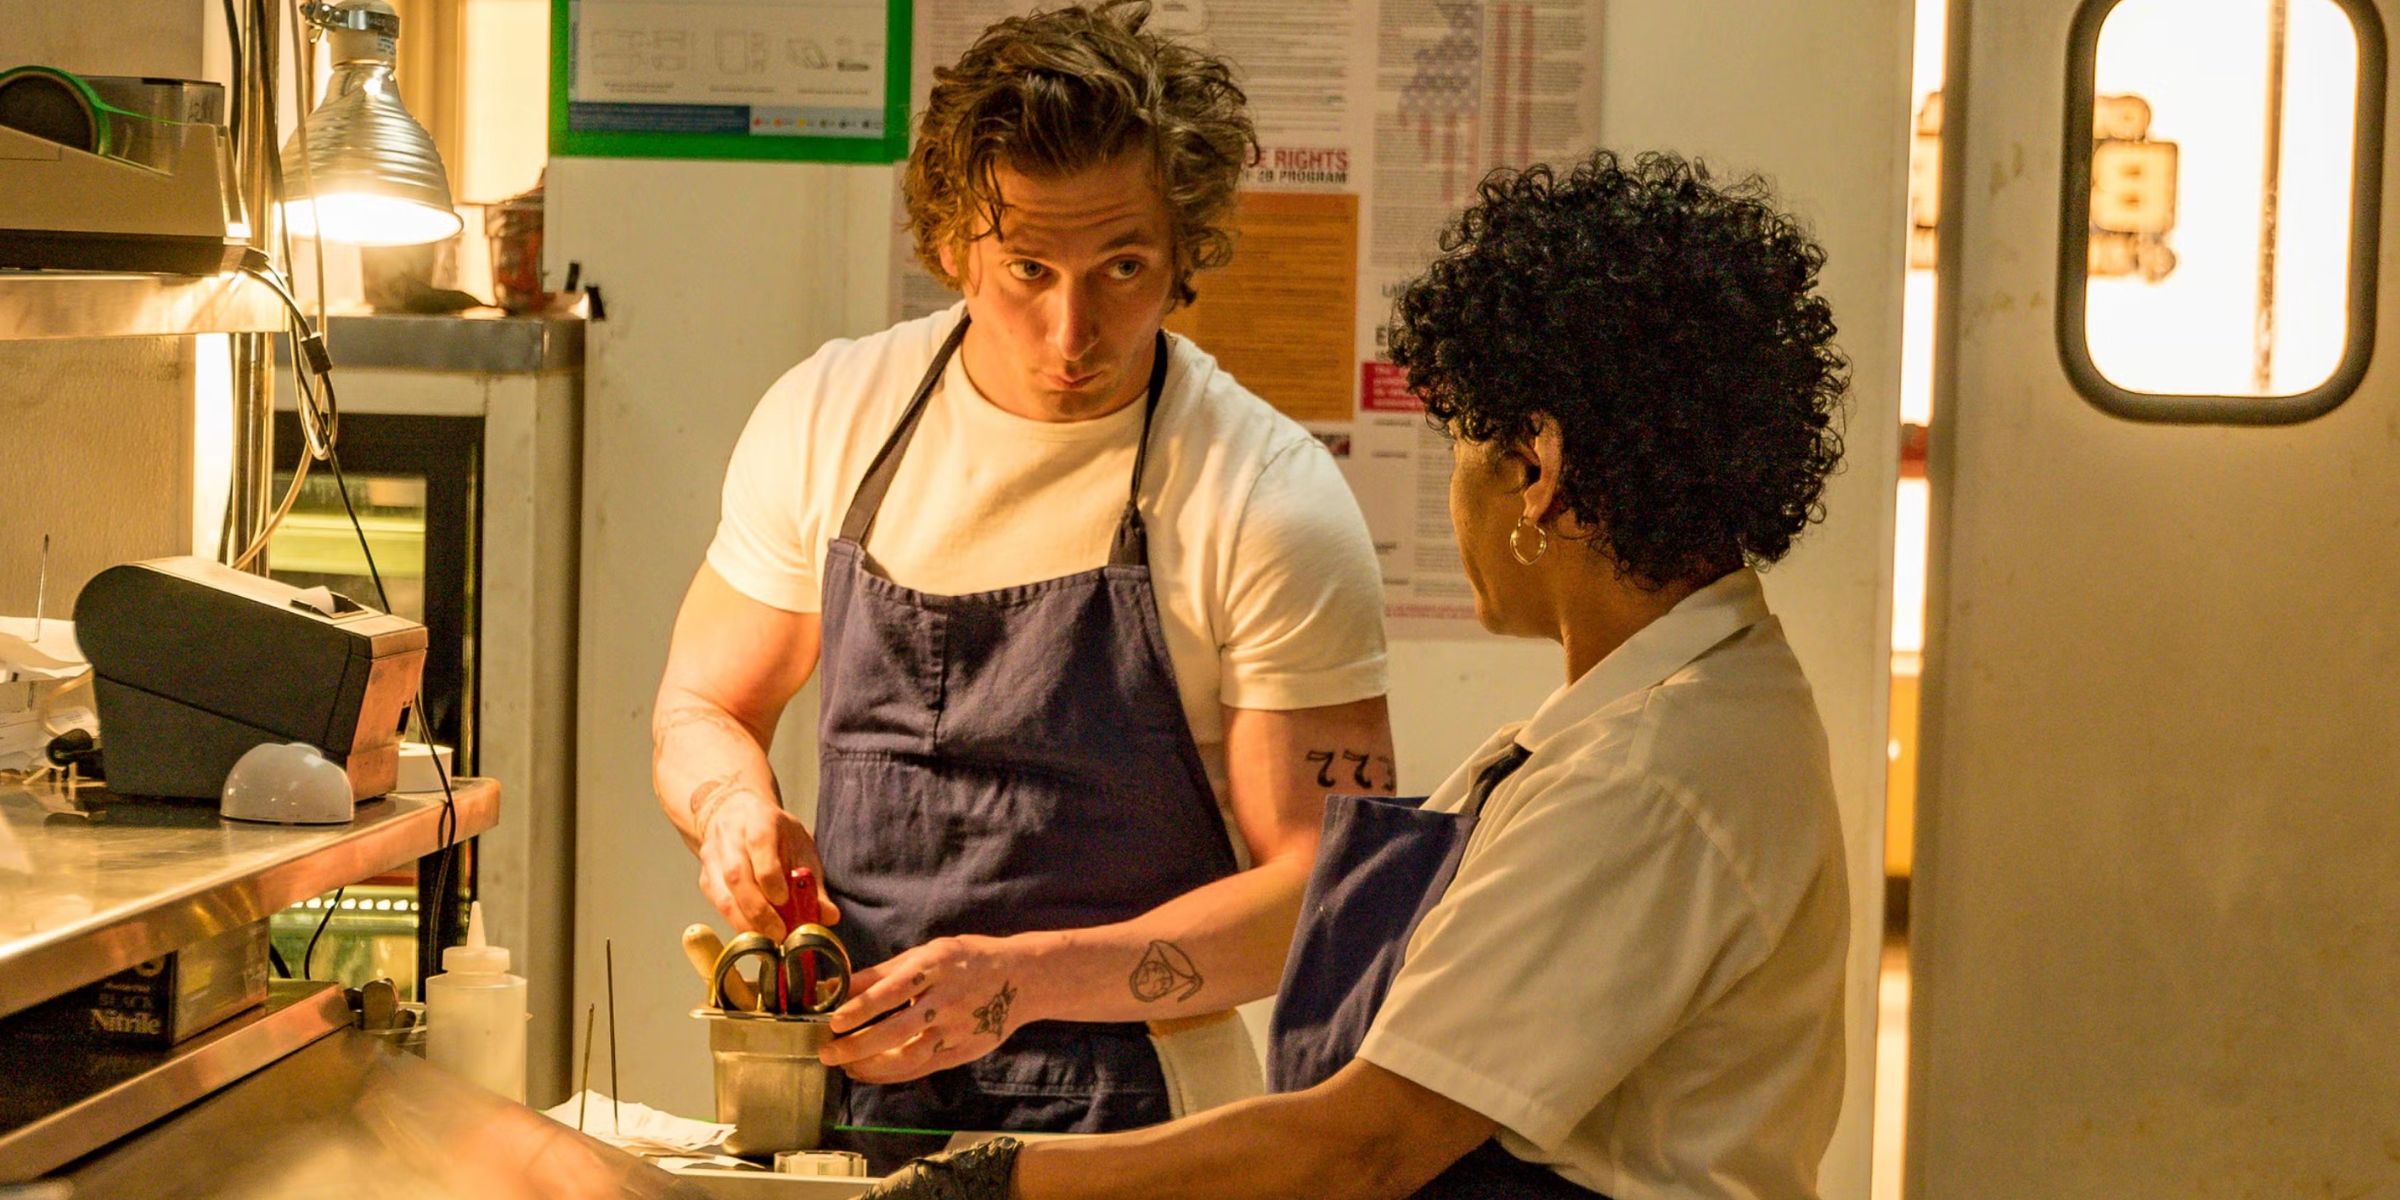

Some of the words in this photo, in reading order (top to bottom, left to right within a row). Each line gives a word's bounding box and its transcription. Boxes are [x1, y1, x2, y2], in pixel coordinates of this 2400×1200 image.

[1274, 149, 1348, 169] RIGHTS
[1279, 169, 1347, 184] PROGRAM
[90, 1007, 162, 1035] Nitrile
